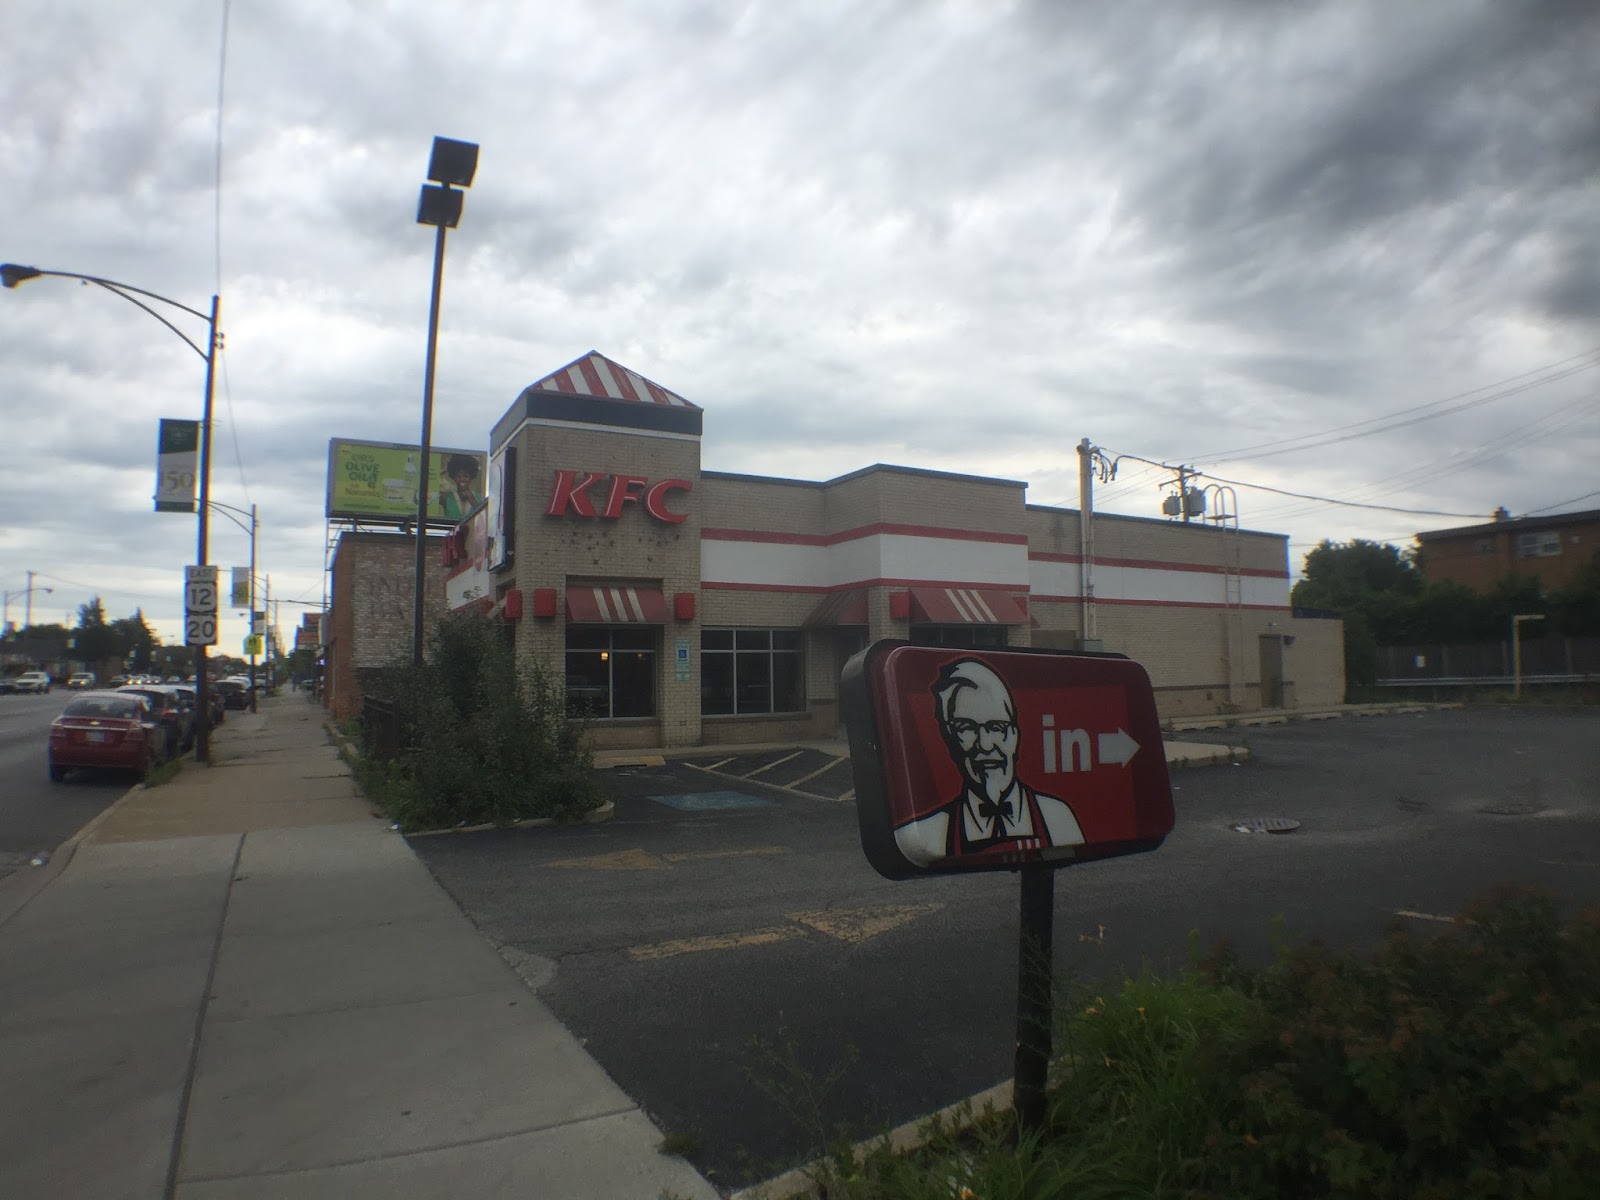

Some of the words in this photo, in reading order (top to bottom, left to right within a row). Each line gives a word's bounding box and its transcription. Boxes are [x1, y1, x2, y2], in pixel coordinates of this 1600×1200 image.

[345, 461, 380, 473] OLIVE
[349, 471, 368, 481] OIL
[544, 469, 693, 524] KFC
[191, 588, 211, 605] 12
[188, 620, 214, 638] 20
[1042, 714, 1092, 773] in
